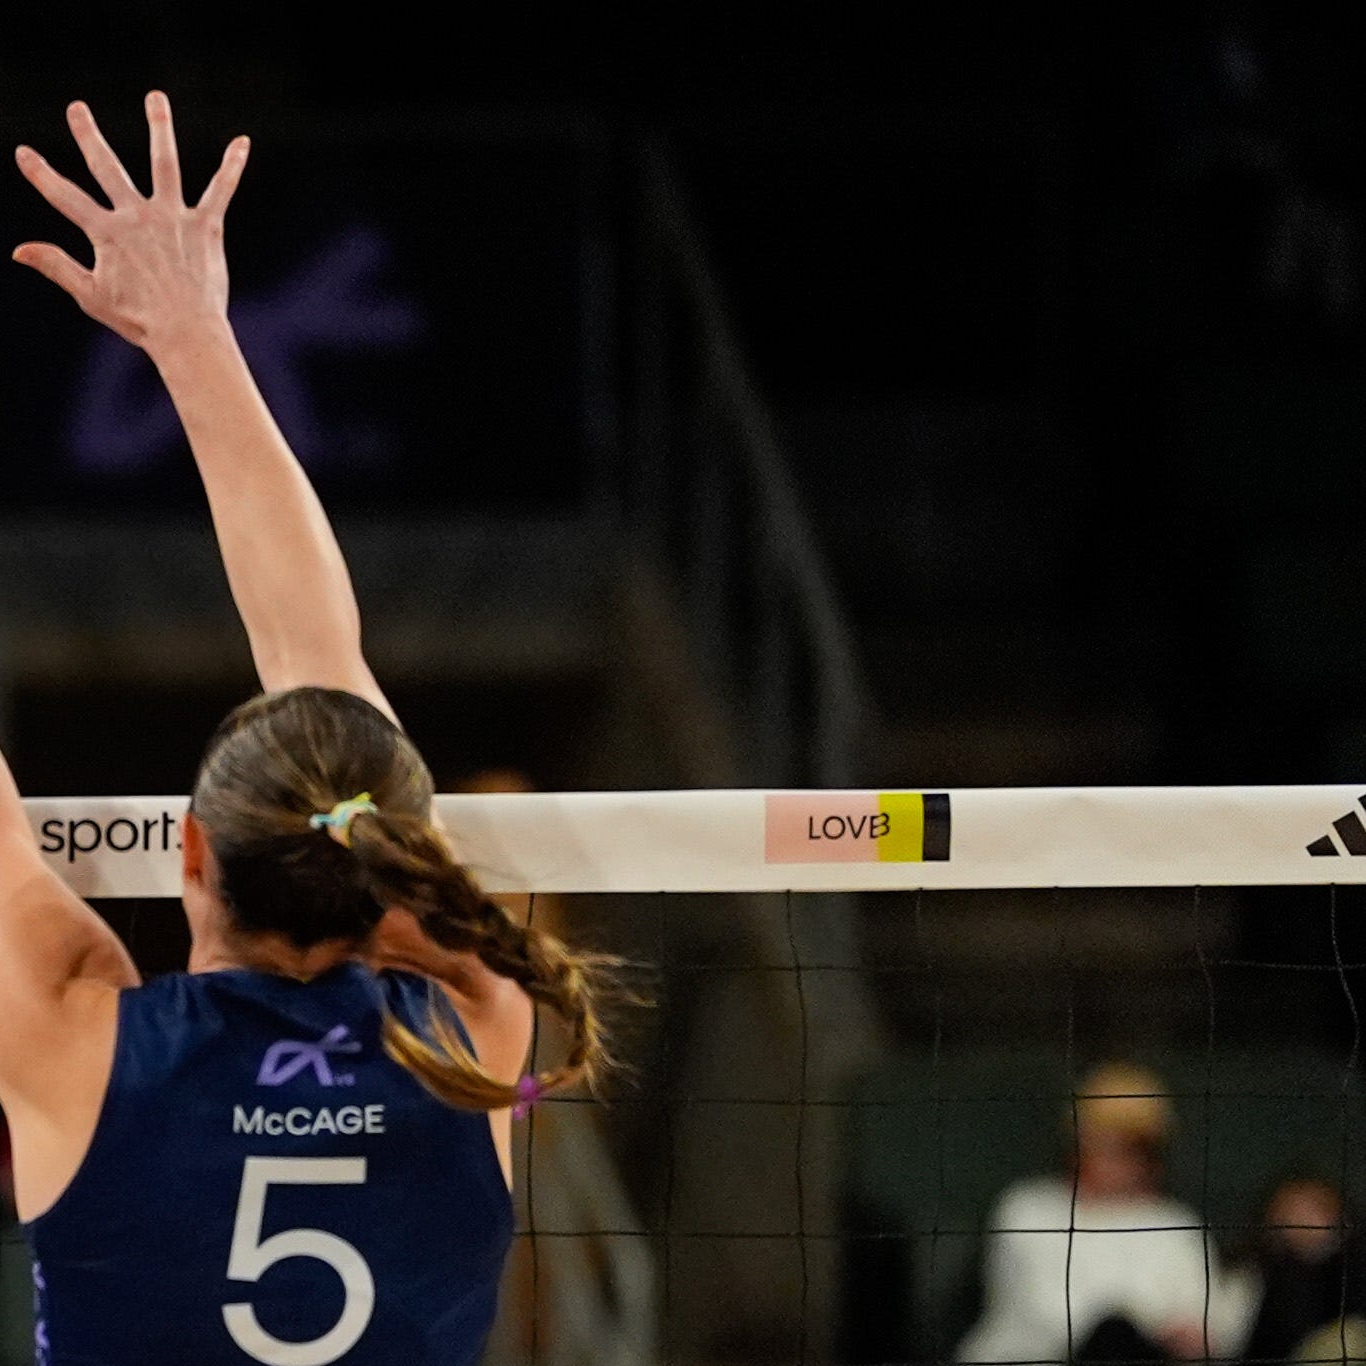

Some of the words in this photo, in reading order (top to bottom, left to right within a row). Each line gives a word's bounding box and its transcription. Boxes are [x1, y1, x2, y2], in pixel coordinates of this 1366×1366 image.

[40, 812, 182, 862] sport
[808, 813, 891, 840] LOVB
[232, 1104, 386, 1136] McCAGE
